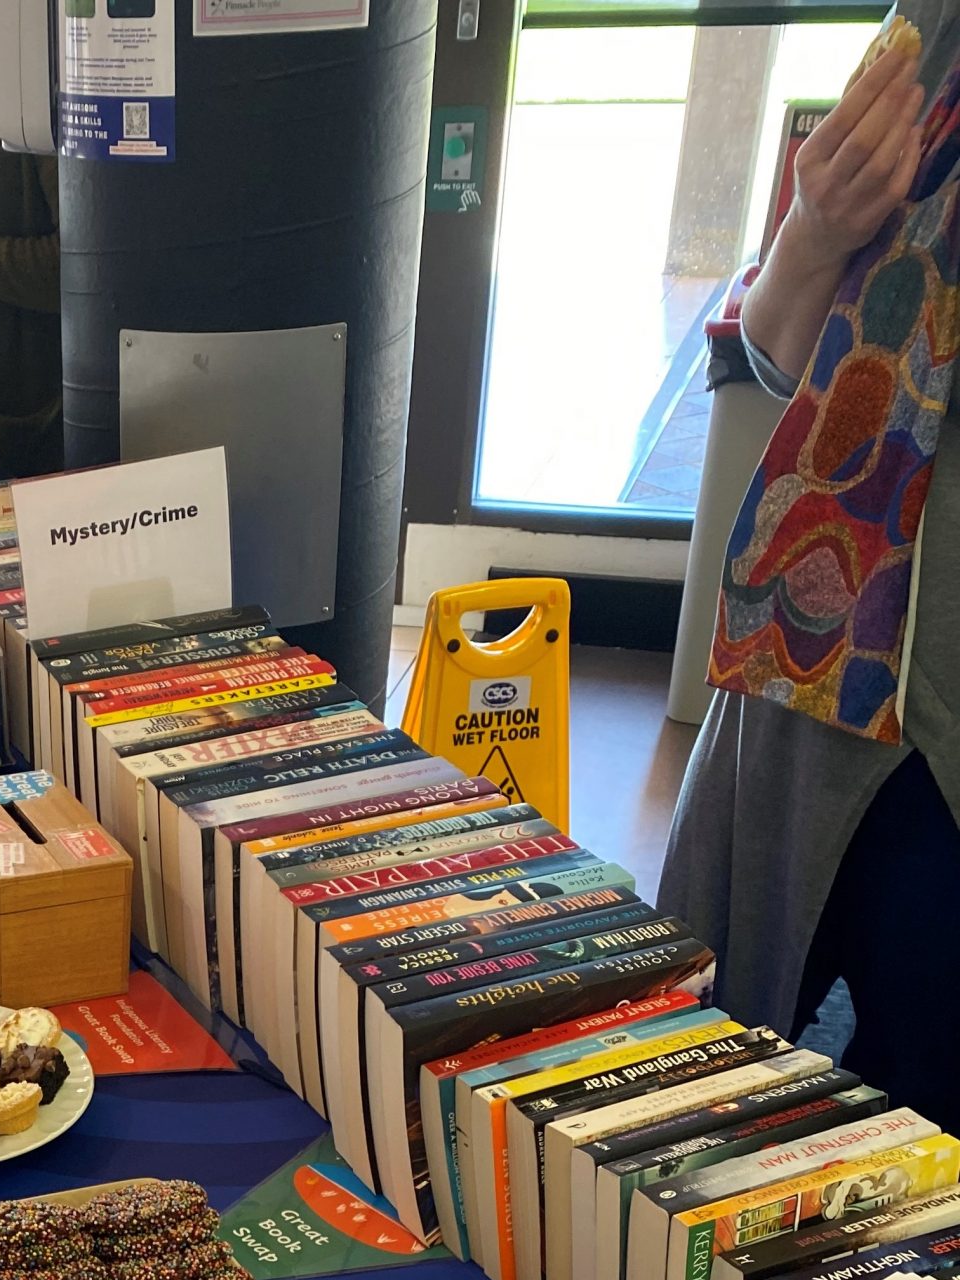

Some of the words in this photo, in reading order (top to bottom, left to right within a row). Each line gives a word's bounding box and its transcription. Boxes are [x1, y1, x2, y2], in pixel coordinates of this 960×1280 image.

[49, 501, 199, 547] Mystery/Crime
[160, 646, 233, 665] CUSSLER
[279, 656, 311, 667] THE
[82, 665, 111, 677] Jungle
[219, 661, 280, 678] HUNTED
[224, 669, 289, 688] PARTISAN
[289, 664, 314, 678] THE
[189, 679, 315, 706] CARETAKERS
[242, 687, 328, 708] HAMMER
[262, 695, 321, 712] CHRIS
[141, 718, 201, 735] TREASURE
[454, 707, 540, 731] CAUTION
[324, 738, 363, 752] SAFE
[364, 733, 395, 743] THE
[452, 730, 485, 747] WET
[488, 725, 540, 743] FLOOR
[272, 747, 321, 762] PLACE
[325, 750, 397, 773] DEATH
[29, 769, 53, 788] The
[263, 764, 324, 784] RELIC
[8, 773, 41, 800] Great
[413, 779, 474, 795] PARIS
[404, 789, 465, 805] LONG
[309, 813, 334, 824] IN
[339, 800, 401, 820] NIGHT
[470, 811, 499, 827] THE
[397, 815, 471, 839] BROTHERS
[490, 824, 533, 841] 22
[302, 840, 351, 854] HINTON
[498, 836, 576, 862] THE
[329, 859, 376, 873] JAMES
[418, 853, 475, 877] AU
[498, 866, 528, 878] THE
[550, 866, 606, 882] McCourt
[312, 867, 409, 898] PAIR
[425, 878, 466, 894] STEVE
[466, 870, 499, 885] PLEA
[568, 874, 606, 887] Kellie
[358, 887, 425, 908] CAVANAGH
[555, 888, 623, 912] MICHAEL
[366, 906, 409, 921] FIRE
[481, 905, 558, 928] CONNELLY
[417, 922, 467, 941] DESERT
[544, 913, 619, 935] FAVOURITE
[376, 931, 416, 949] STAR
[592, 922, 671, 949] ROBOTHAM
[398, 947, 448, 963] KNOLL
[398, 952, 460, 971] JESSICA
[500, 952, 540, 970] LYING
[593, 946, 678, 971] CANDLISH
[615, 953, 672, 973] LOUISE
[425, 971, 457, 987] YOU
[455, 960, 502, 980] BESIDE
[548, 971, 581, 987] the
[455, 980, 545, 1008] heights
[624, 997, 672, 1015] SILENT
[576, 1010, 625, 1031] PATIENT
[77, 1005, 99, 1028] Great
[96, 1023, 115, 1047] Book
[112, 1041, 135, 1066] Swap
[662, 1025, 732, 1051] JEEVES
[706, 1039, 746, 1055] The
[622, 1048, 709, 1081] Gangland
[582, 1073, 627, 1091] War
[748, 1075, 827, 1103] MAIDENS
[882, 1116, 917, 1132] THE
[799, 1126, 883, 1158] CHESTNUT
[758, 1151, 800, 1170] MAN
[280, 1209, 330, 1246] Great
[839, 1212, 897, 1235] HELLER
[232, 1226, 278, 1263] Swap
[258, 1218, 303, 1254] Book
